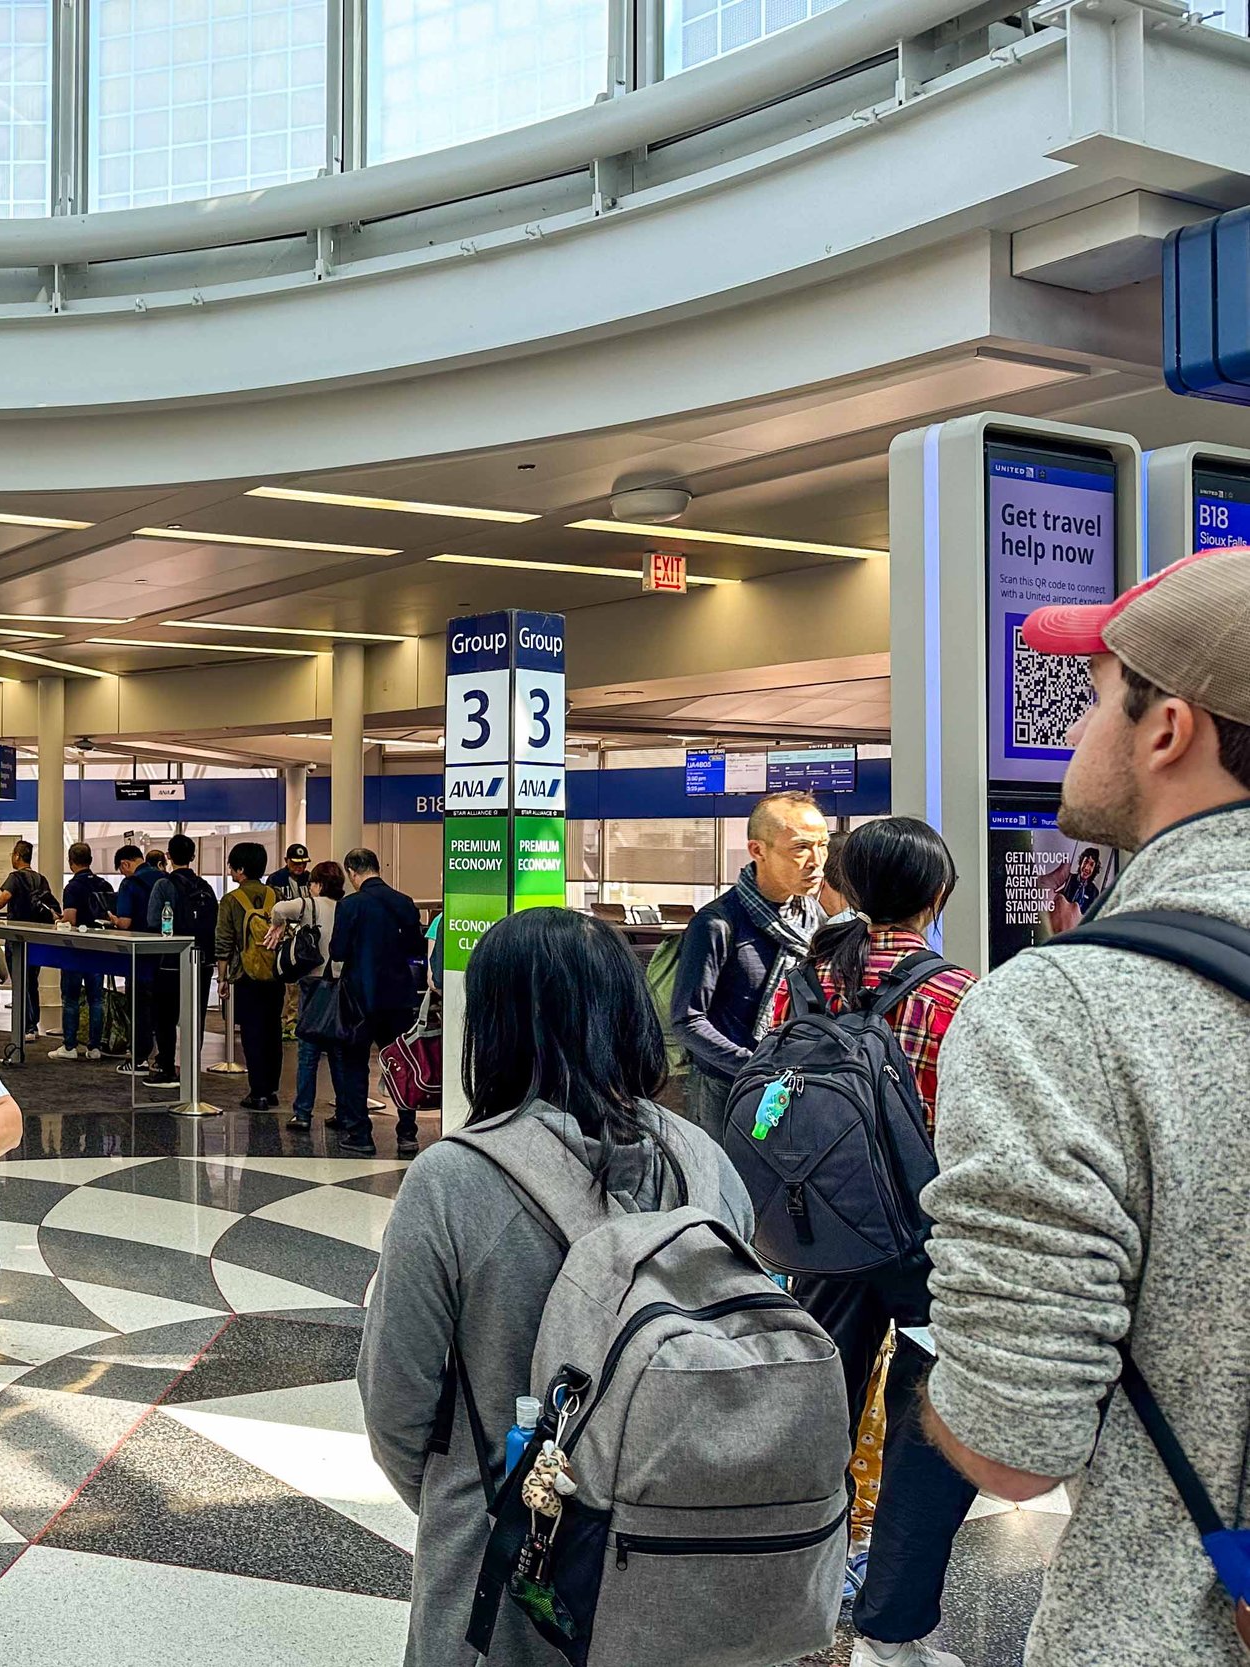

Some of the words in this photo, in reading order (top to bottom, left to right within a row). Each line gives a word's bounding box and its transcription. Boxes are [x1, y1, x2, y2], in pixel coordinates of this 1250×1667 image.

[995, 464, 1025, 476] UNITED
[1001, 504, 1037, 528] Get
[1042, 509, 1102, 537] travel
[1199, 504, 1229, 529] B18
[1200, 531, 1227, 547] Sioux
[1001, 532, 1046, 566] help
[1052, 543, 1095, 566] now
[654, 556, 682, 582] EXIT
[1000, 574, 1018, 585] Scan
[1020, 576, 1034, 587] this
[1035, 578, 1047, 590] QR
[1048, 580, 1066, 590] code
[1068, 582, 1076, 591] to
[1077, 584, 1106, 595] connect
[1000, 588, 1018, 599] with
[1019, 592, 1024, 600] a
[1026, 590, 1050, 602] United
[1052, 594, 1078, 606] airport
[452, 631, 506, 655] Group
[519, 628, 563, 657] Group
[461, 689, 491, 750] 3
[528, 688, 551, 748] 3
[449, 780, 484, 798] ANA
[518, 779, 547, 797] ANA
[450, 840, 501, 852] PREMIUM
[519, 840, 560, 853] PREMIUM
[448, 858, 503, 872] ECONOMY
[518, 857, 561, 872] ECONOMY
[1006, 852, 1025, 863] GET
[1026, 852, 1036, 863] IN
[1036, 852, 1070, 864] TOUCH
[1006, 864, 1031, 876] WITH
[1032, 864, 1046, 876] AN
[1006, 876, 1038, 888] AGENT
[1006, 888, 1050, 900] WITHOUT
[1006, 900, 1055, 912] STANDING
[1006, 912, 1017, 924] IN
[1018, 912, 1042, 924] LINE.
